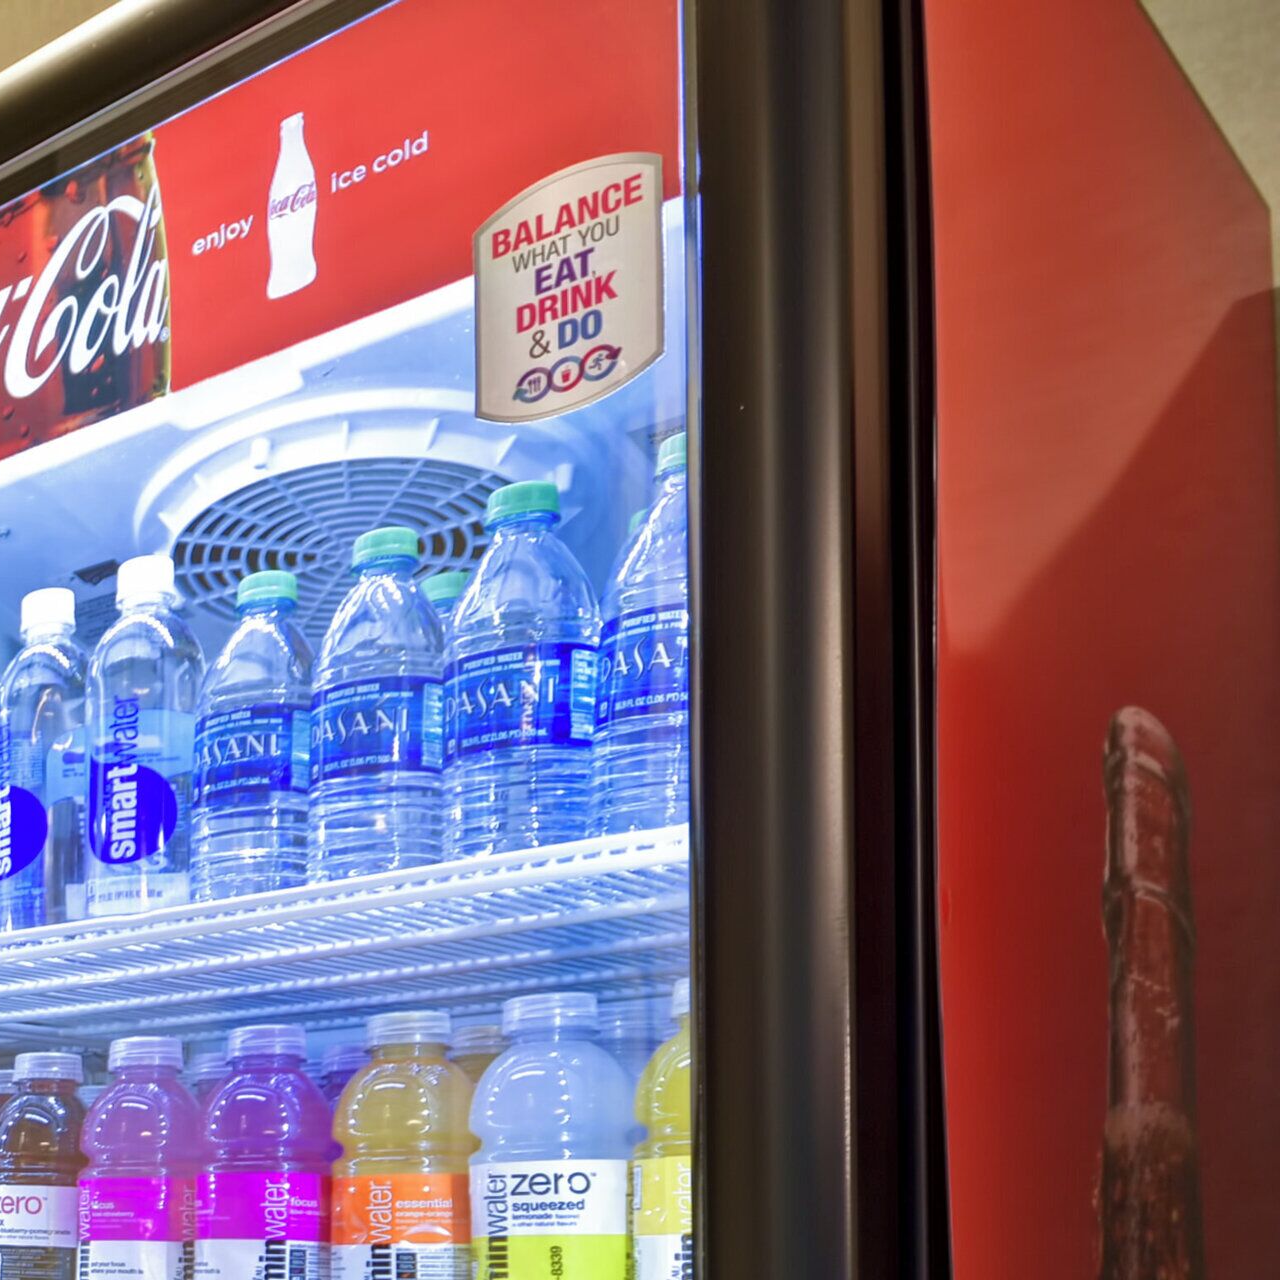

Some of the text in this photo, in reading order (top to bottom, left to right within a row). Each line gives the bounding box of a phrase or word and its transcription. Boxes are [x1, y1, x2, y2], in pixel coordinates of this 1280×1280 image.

[329, 130, 428, 193] ice cold
[267, 181, 316, 221] Coca-Cola
[491, 173, 643, 260] BALANCE
[191, 212, 255, 257] enjoy
[512, 214, 620, 273] WHAT YOU
[516, 269, 618, 333] DRINK
[529, 309, 602, 358] & DO
[602, 637, 686, 684] DASA
[312, 706, 408, 748] DASANI
[290, 1197, 318, 1208] focus
[396, 1199, 453, 1209] essential
[510, 1172, 591, 1196] zero
[512, 1199, 585, 1213] squeezed
